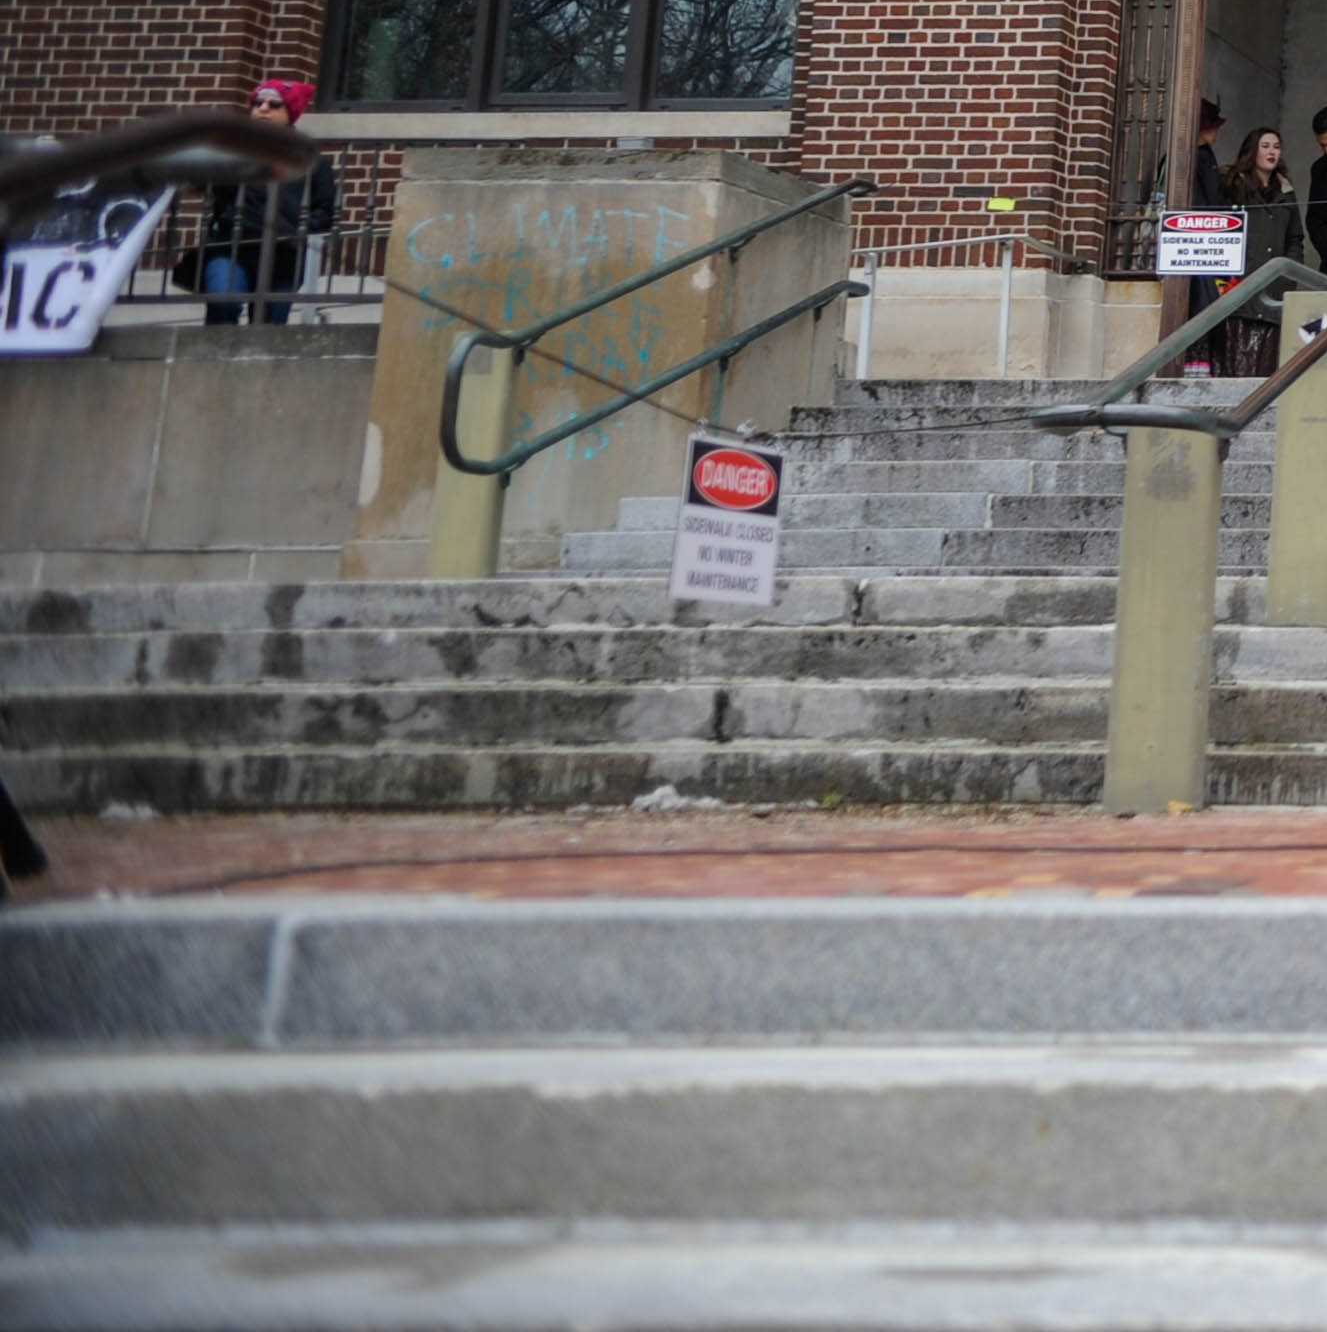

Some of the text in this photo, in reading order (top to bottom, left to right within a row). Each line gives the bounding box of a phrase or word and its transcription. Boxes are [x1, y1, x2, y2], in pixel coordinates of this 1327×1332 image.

[1176, 217, 1229, 229] DANGER
[407, 203, 691, 268] CLIMATE
[1162, 237, 1241, 245] SIDEWALK CLOSED
[1170, 259, 1230, 267] MAINTENANCE
[1177, 248, 1225, 256] NO WINTER
[0, 261, 96, 330] IC
[701, 459, 769, 497] DANGER
[684, 515, 774, 544] SIDEWALK CLOSED
[699, 546, 753, 567] NO WINTER
[687, 570, 760, 595] MAINTENANCE
